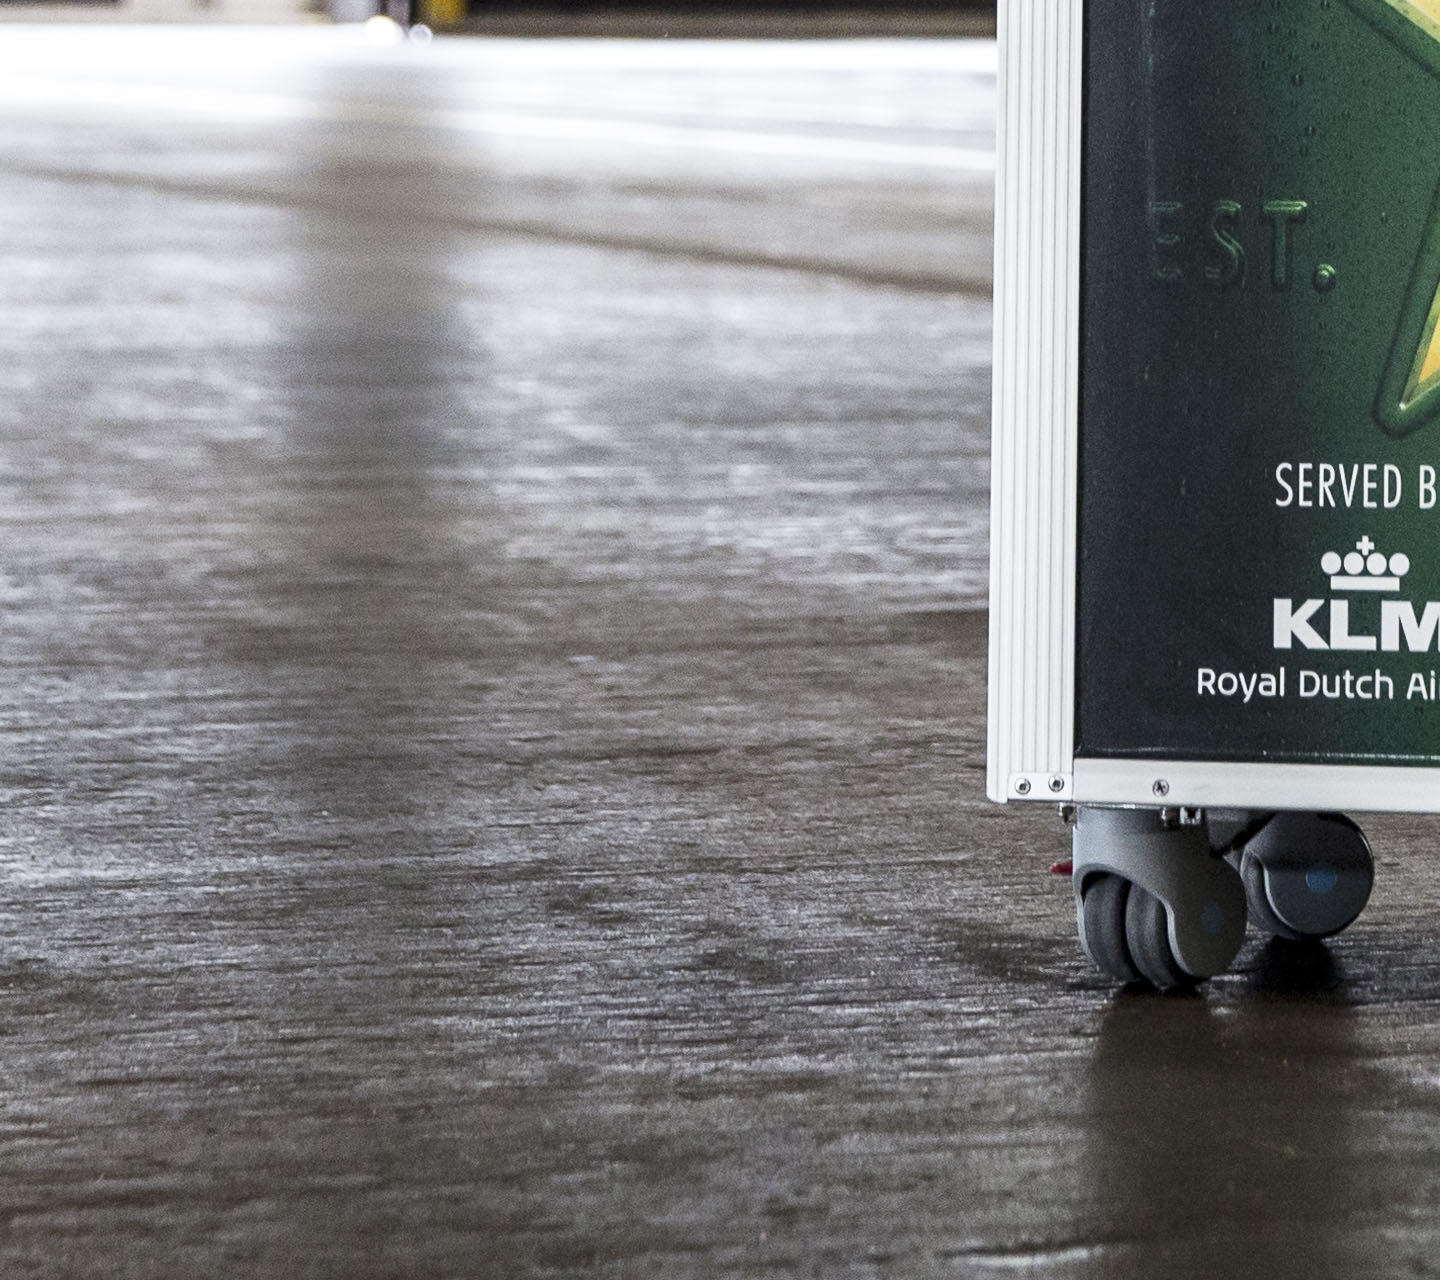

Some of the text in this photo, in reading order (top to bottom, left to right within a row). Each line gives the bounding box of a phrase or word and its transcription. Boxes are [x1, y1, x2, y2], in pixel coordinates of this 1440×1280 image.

[1148, 199, 1336, 292] EST.
[1275, 462, 1402, 509] SERVED
[1197, 666, 1285, 704] Royal
[1299, 668, 1394, 699] Dutch
